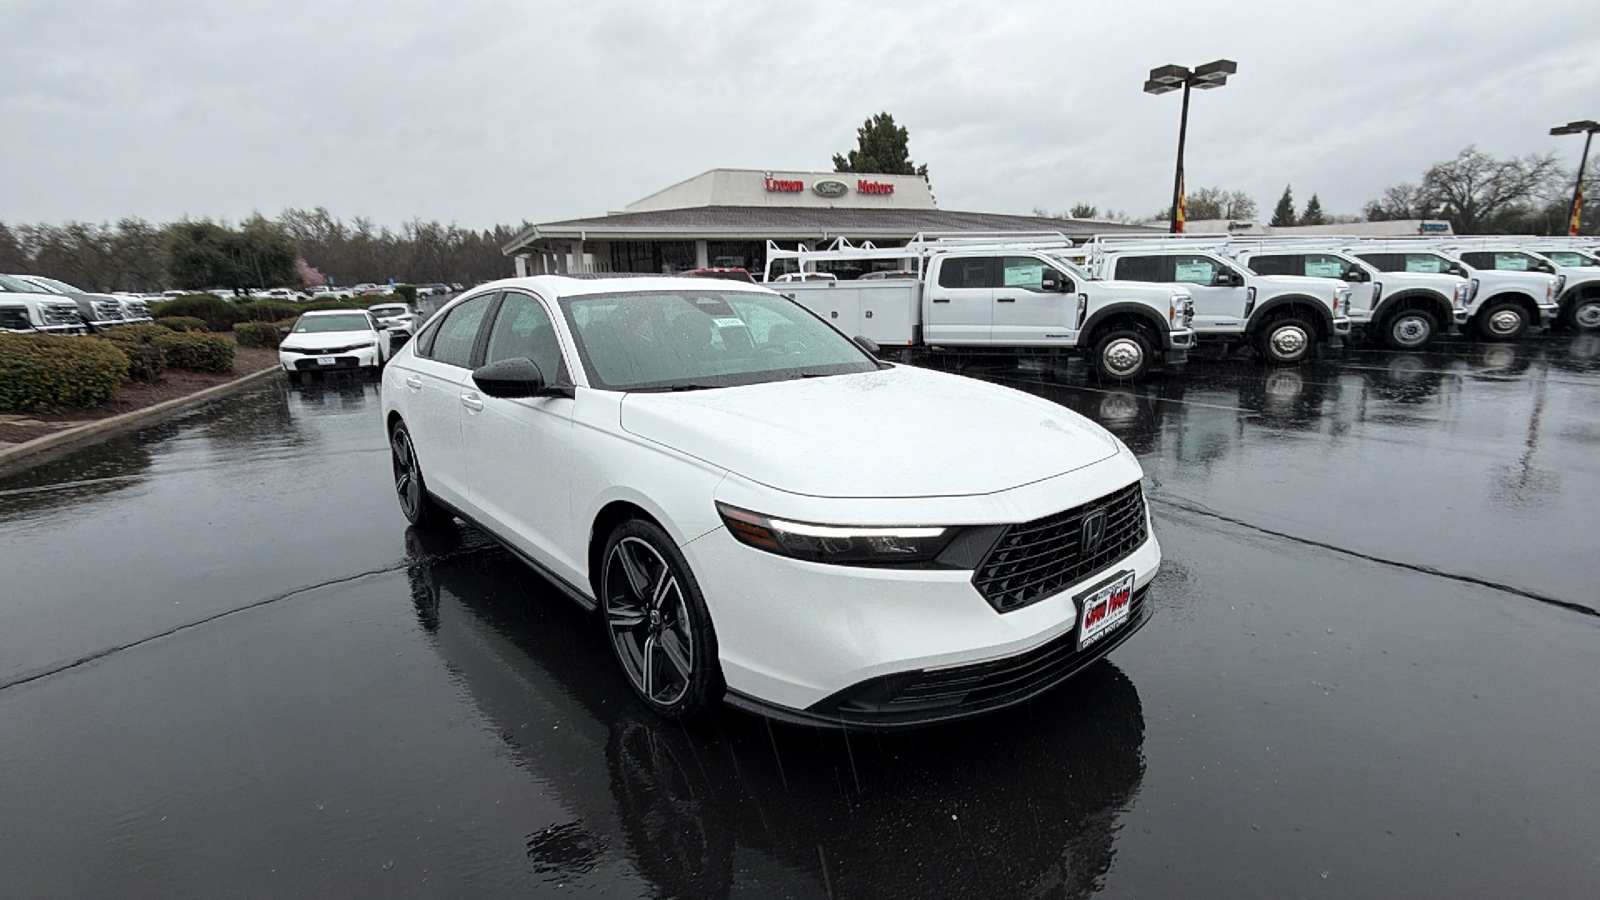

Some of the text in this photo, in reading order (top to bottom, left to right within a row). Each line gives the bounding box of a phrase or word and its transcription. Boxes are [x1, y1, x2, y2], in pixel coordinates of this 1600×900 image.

[765, 177, 894, 194] Crown Ford Motors
[1082, 631, 1104, 648] CROWN
[1104, 615, 1128, 634] MOTORS
